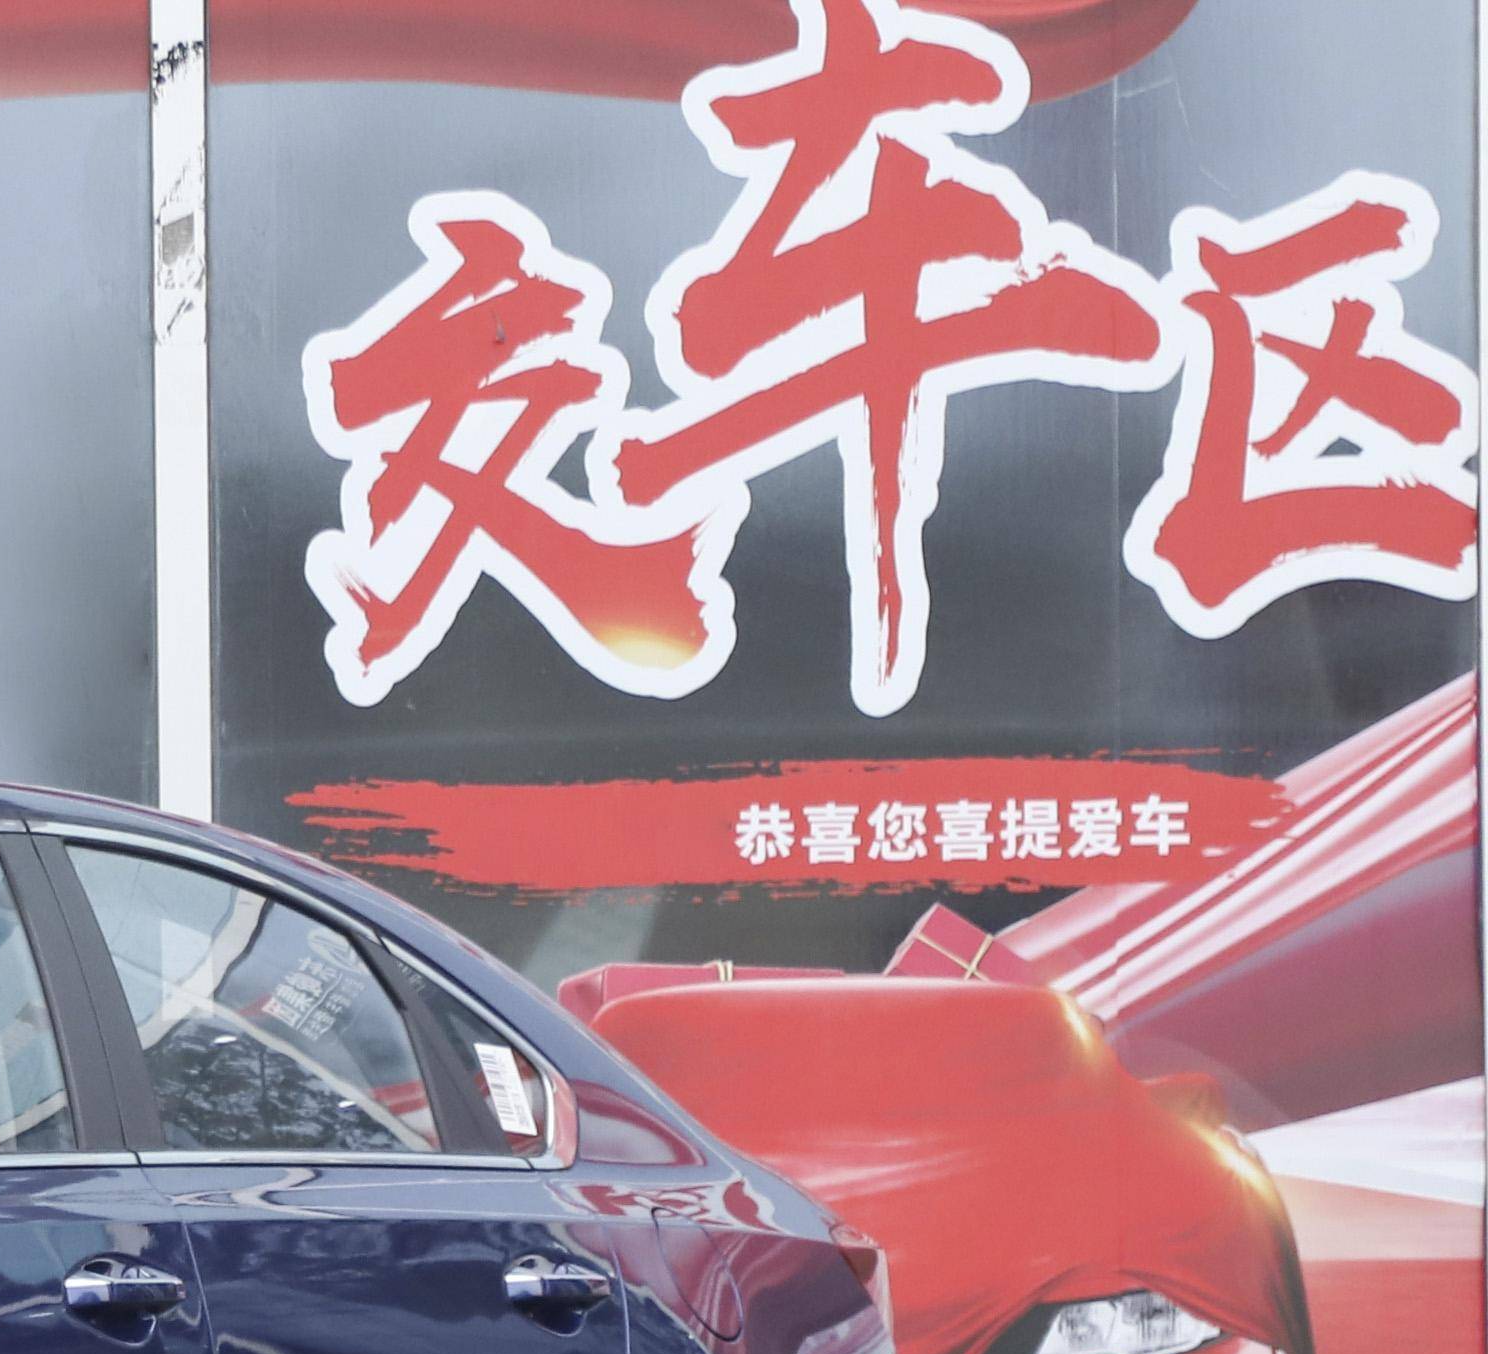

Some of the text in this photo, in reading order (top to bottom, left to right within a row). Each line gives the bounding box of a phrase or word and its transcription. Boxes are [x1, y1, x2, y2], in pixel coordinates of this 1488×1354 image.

[319, 0, 1478, 698] 交车区
[735, 793, 1192, 865] 恭喜您喜提爱车
